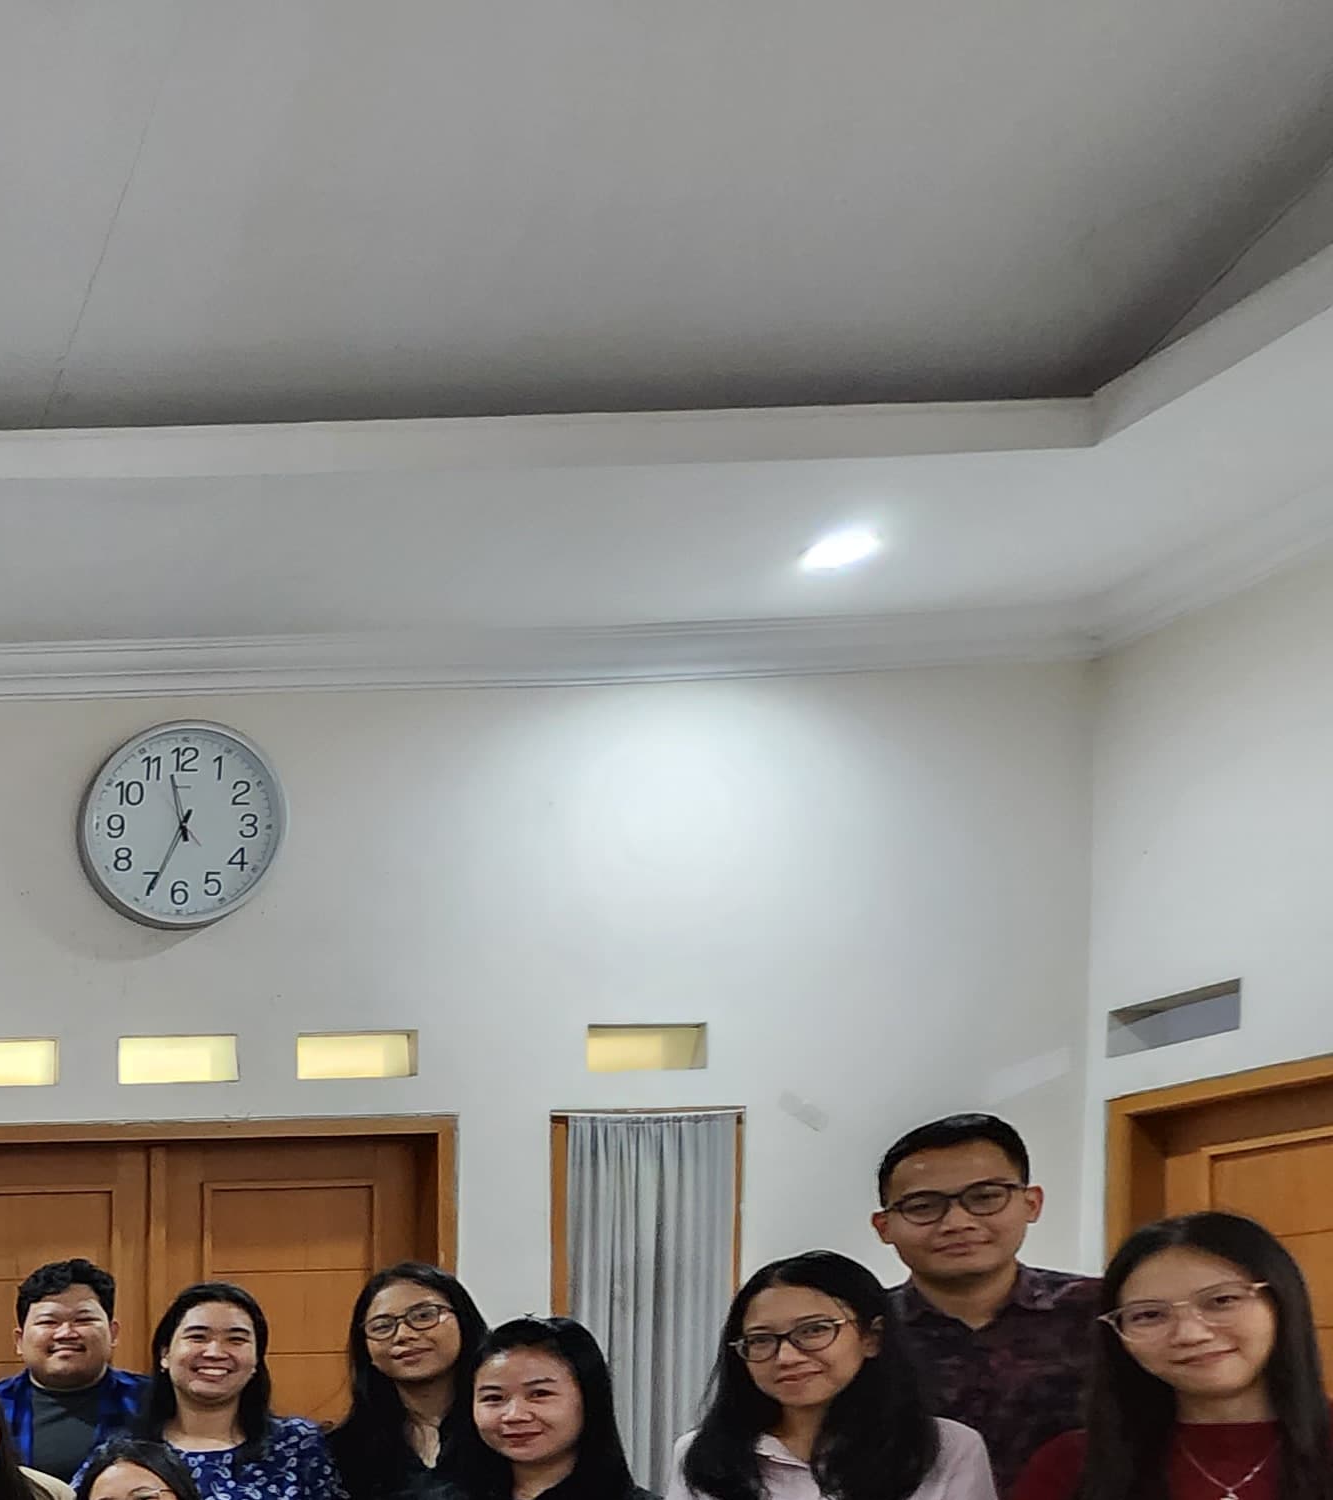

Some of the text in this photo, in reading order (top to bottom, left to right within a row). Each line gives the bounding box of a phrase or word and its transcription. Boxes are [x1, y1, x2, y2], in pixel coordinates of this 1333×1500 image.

[141, 756, 162, 781] 11
[171, 747, 199, 772] 12
[213, 755, 223, 781] 1
[115, 781, 144, 806] 10
[231, 781, 251, 806] 2
[106, 814, 125, 838] 9
[239, 814, 258, 838] 3
[113, 847, 132, 872] 8
[227, 847, 248, 872] 4
[142, 872, 160, 896] 7
[170, 881, 189, 905] 6
[203, 872, 222, 896] 5
